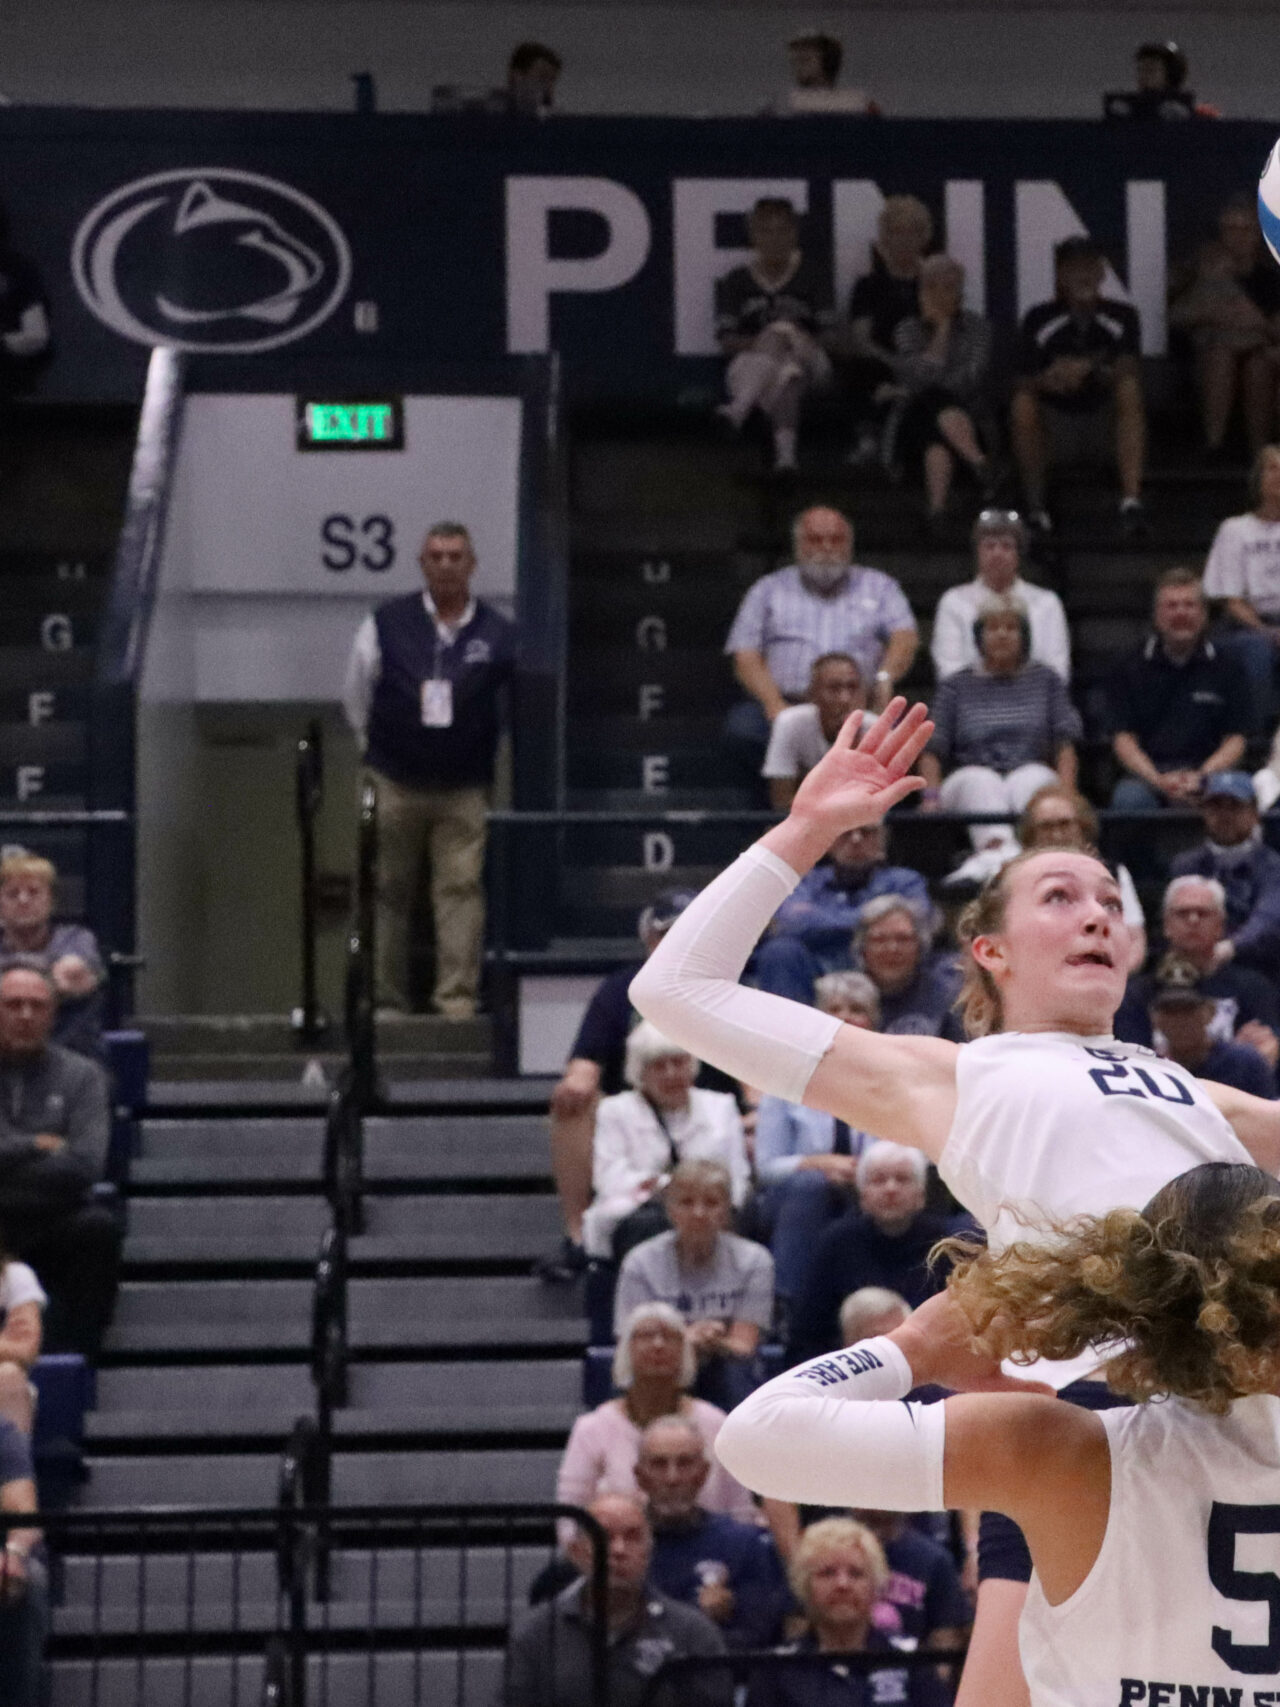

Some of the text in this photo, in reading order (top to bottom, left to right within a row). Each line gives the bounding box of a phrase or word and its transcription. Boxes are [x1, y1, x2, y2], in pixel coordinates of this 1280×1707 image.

[310, 403, 392, 440] EXIT
[320, 512, 397, 573] S3
[40, 613, 73, 652] G
[643, 755, 669, 797] E
[643, 831, 675, 873] D
[1088, 1063, 1196, 1106] 20
[835, 1348, 884, 1376] WE
[1118, 1678, 1243, 1707] PENN
